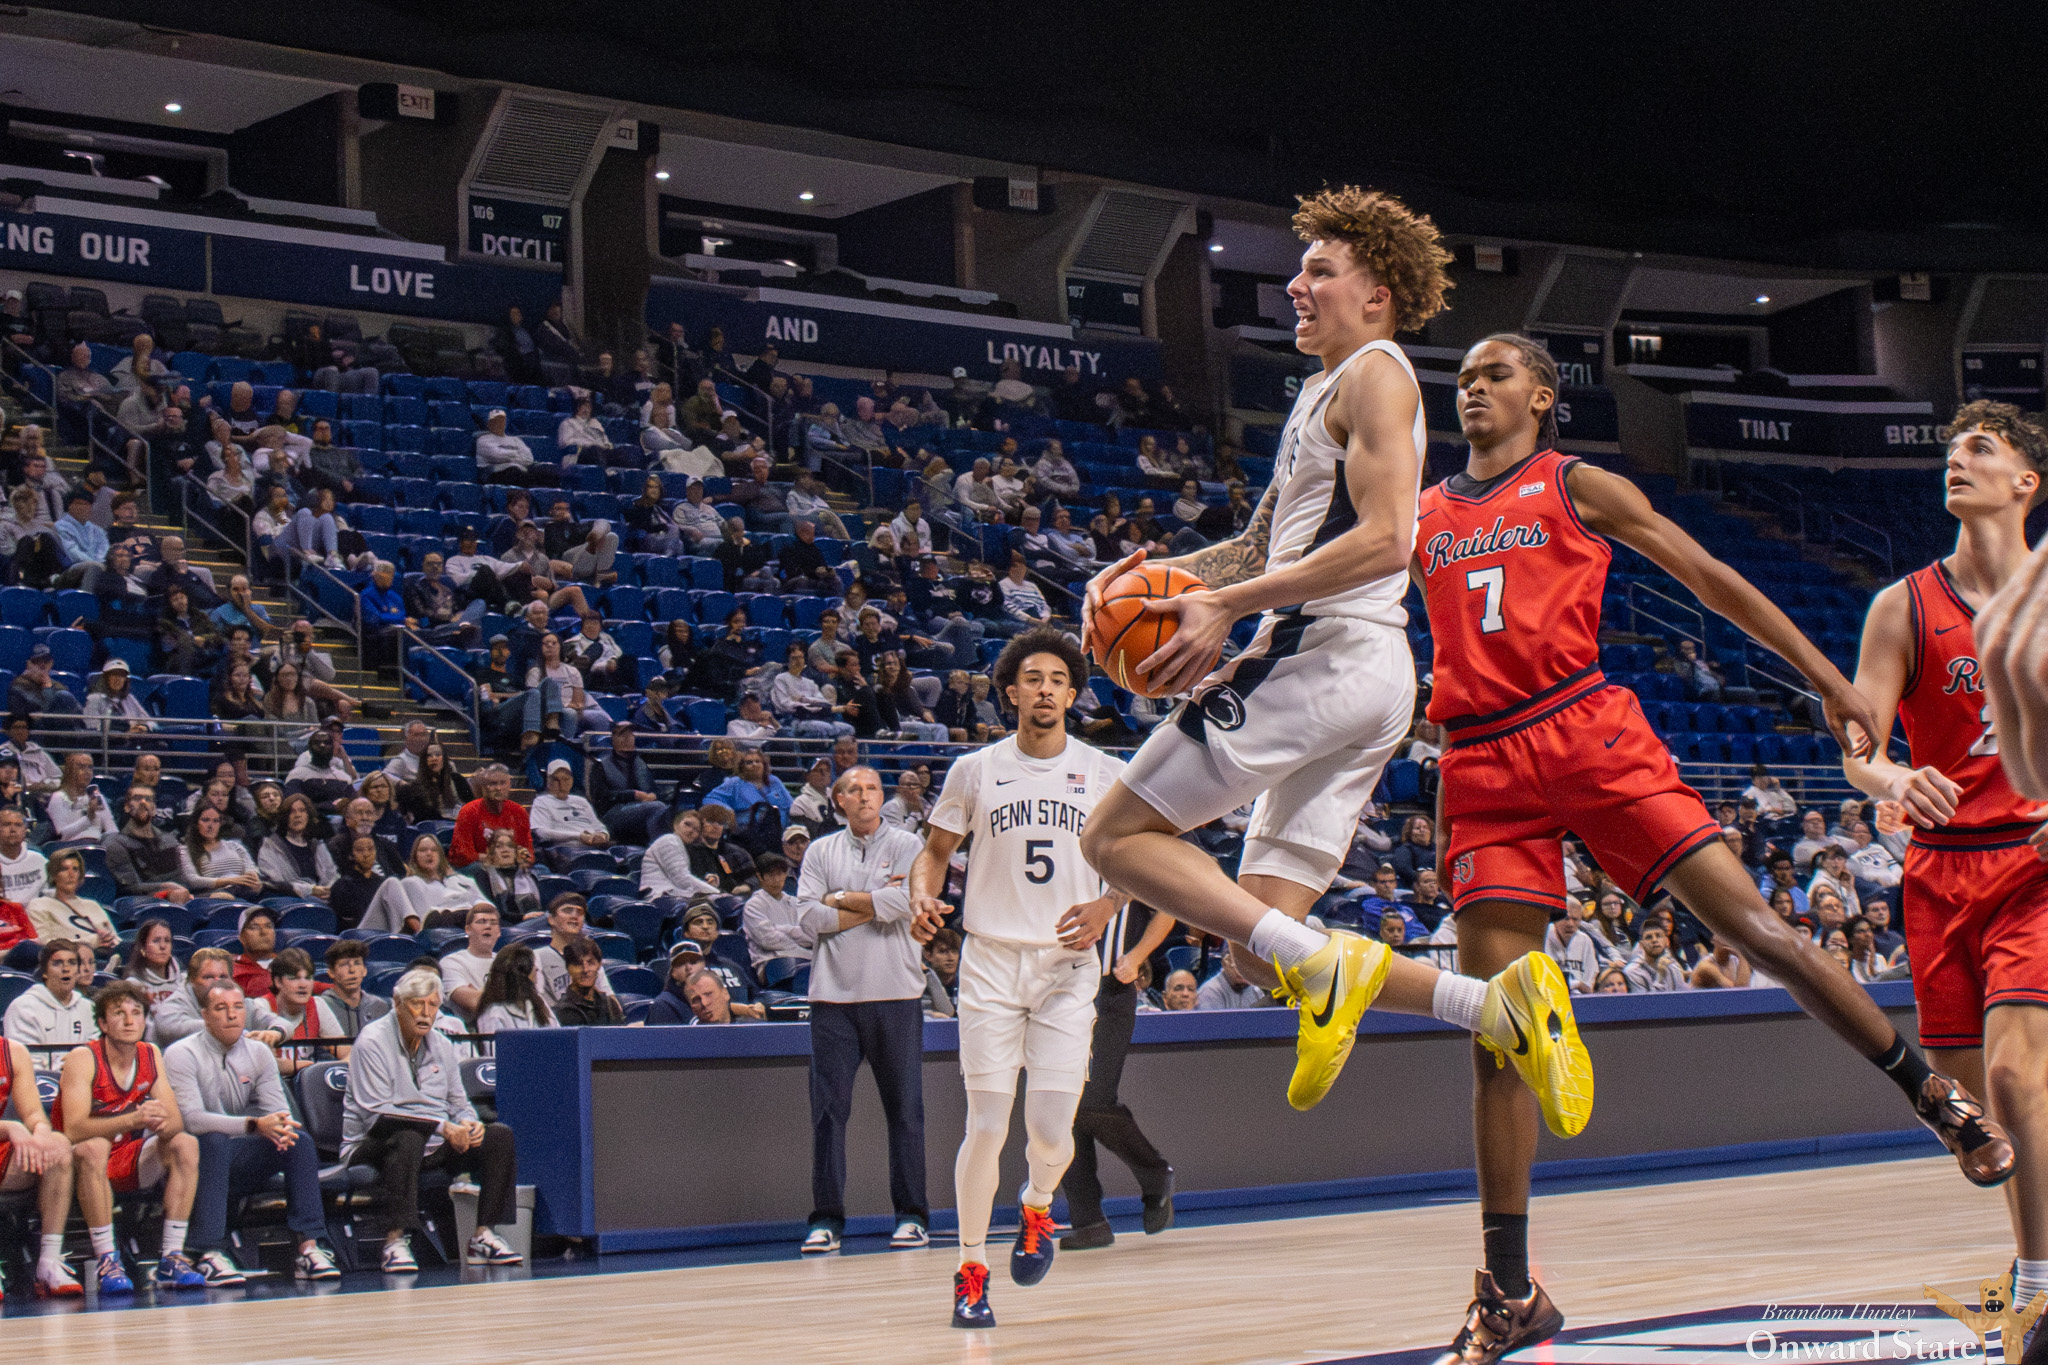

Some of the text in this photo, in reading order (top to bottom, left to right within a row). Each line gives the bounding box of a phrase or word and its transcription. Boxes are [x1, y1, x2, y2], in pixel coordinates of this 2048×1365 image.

[400, 93, 431, 110] EXIT
[0, 223, 150, 267] NG OUR
[350, 264, 436, 300] LOVE
[765, 315, 819, 343] AND
[1427, 516, 1549, 576] Raiders
[1466, 565, 1506, 635] 7
[990, 799, 1087, 838] PENN STATE
[1024, 839, 1055, 884] 5
